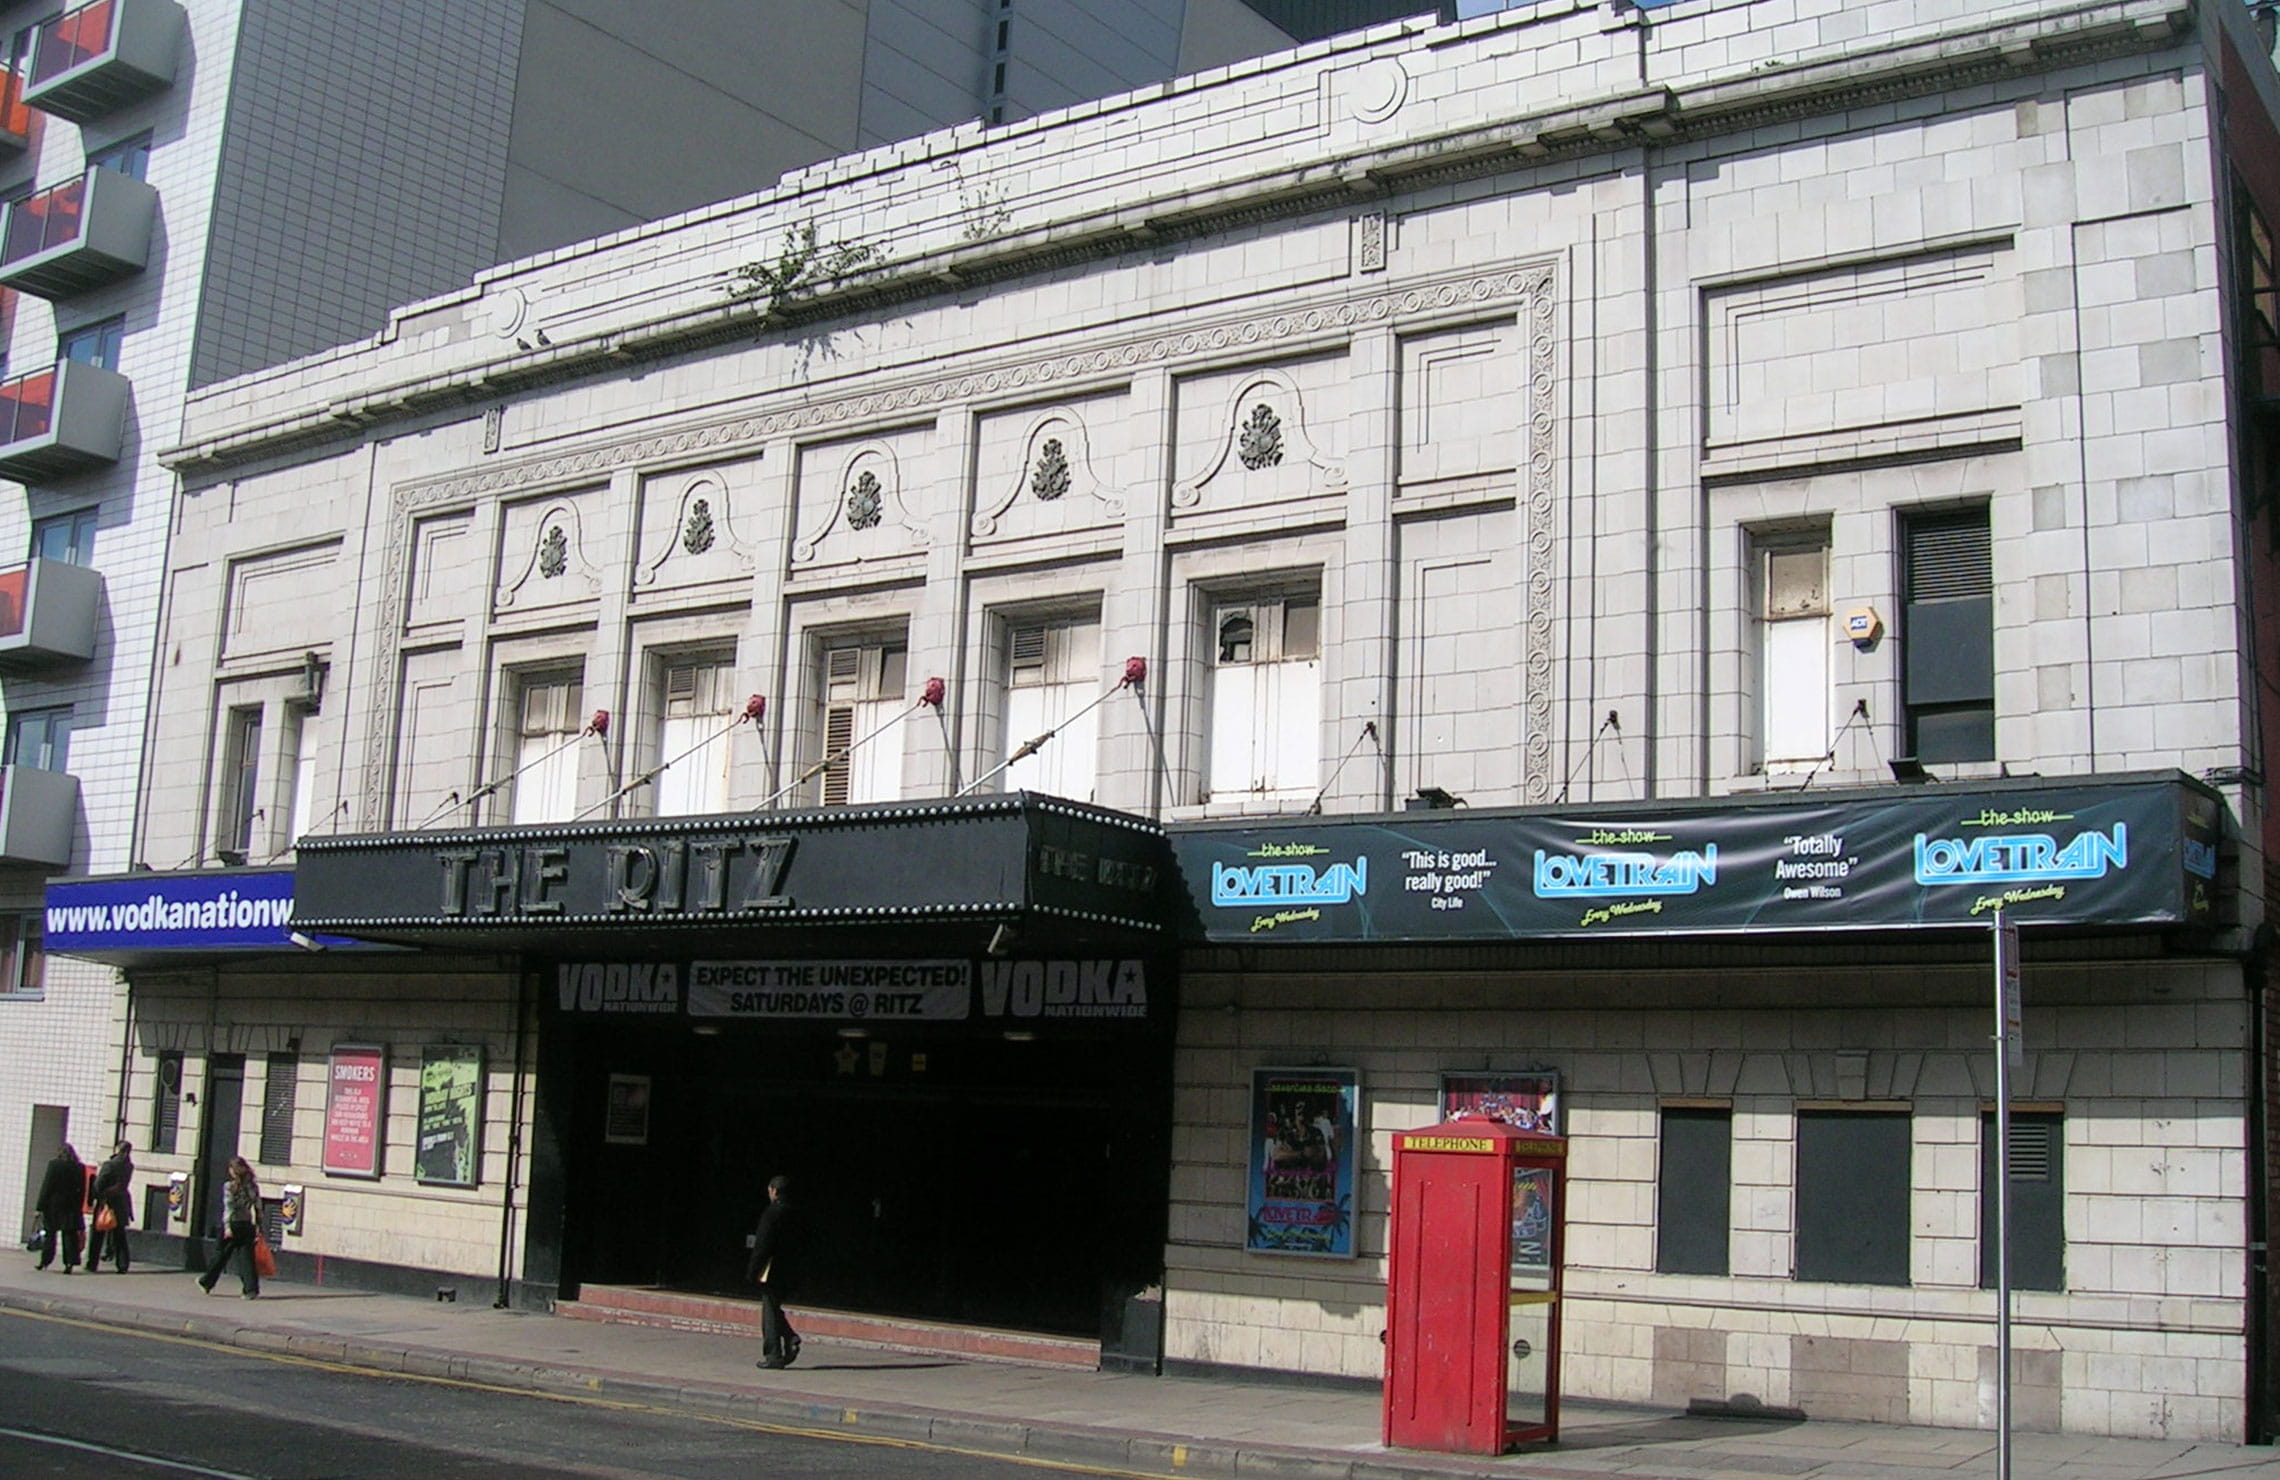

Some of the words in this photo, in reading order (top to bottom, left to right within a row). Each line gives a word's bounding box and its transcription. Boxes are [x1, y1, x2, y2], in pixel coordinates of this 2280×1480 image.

[1980, 808, 2008, 826] the
[2012, 806, 2054, 824] show
[1592, 828, 1615, 844] the
[1619, 827, 1655, 843] show
[1261, 842, 1282, 857] the
[1285, 841, 1315, 856] show
[1438, 850, 1450, 868] is
[1914, 821, 2127, 886] LOVETRAIN
[436, 846, 569, 915] THE
[604, 836, 799, 914] RITZ
[1533, 842, 1718, 898] LOVETRAIN
[1211, 855, 1368, 907] LOVETRAIN
[1405, 872, 1442, 893] really
[1810, 886, 1841, 898] Wilson
[1970, 896, 2004, 916] Every
[2003, 883, 2065, 903] Wednesday
[1431, 896, 1447, 911] City
[1448, 896, 1463, 908] Life
[1609, 897, 1662, 916] Wednesday
[696, 966, 771, 986] EXPECT
[774, 966, 815, 986] THE
[819, 965, 967, 987] UNEXPECTED!
[558, 962, 679, 1012] VODKA
[981, 960, 1148, 1017] VODKA
[730, 991, 844, 1014] SATURDAYS
[850, 993, 869, 1016] @
[874, 993, 922, 1014] RITZ
[1044, 1003, 1148, 1018] NATIONWIDE
[334, 1065, 376, 1082] SMOKERS
[1411, 1137, 1488, 1151] TELEPHONE
